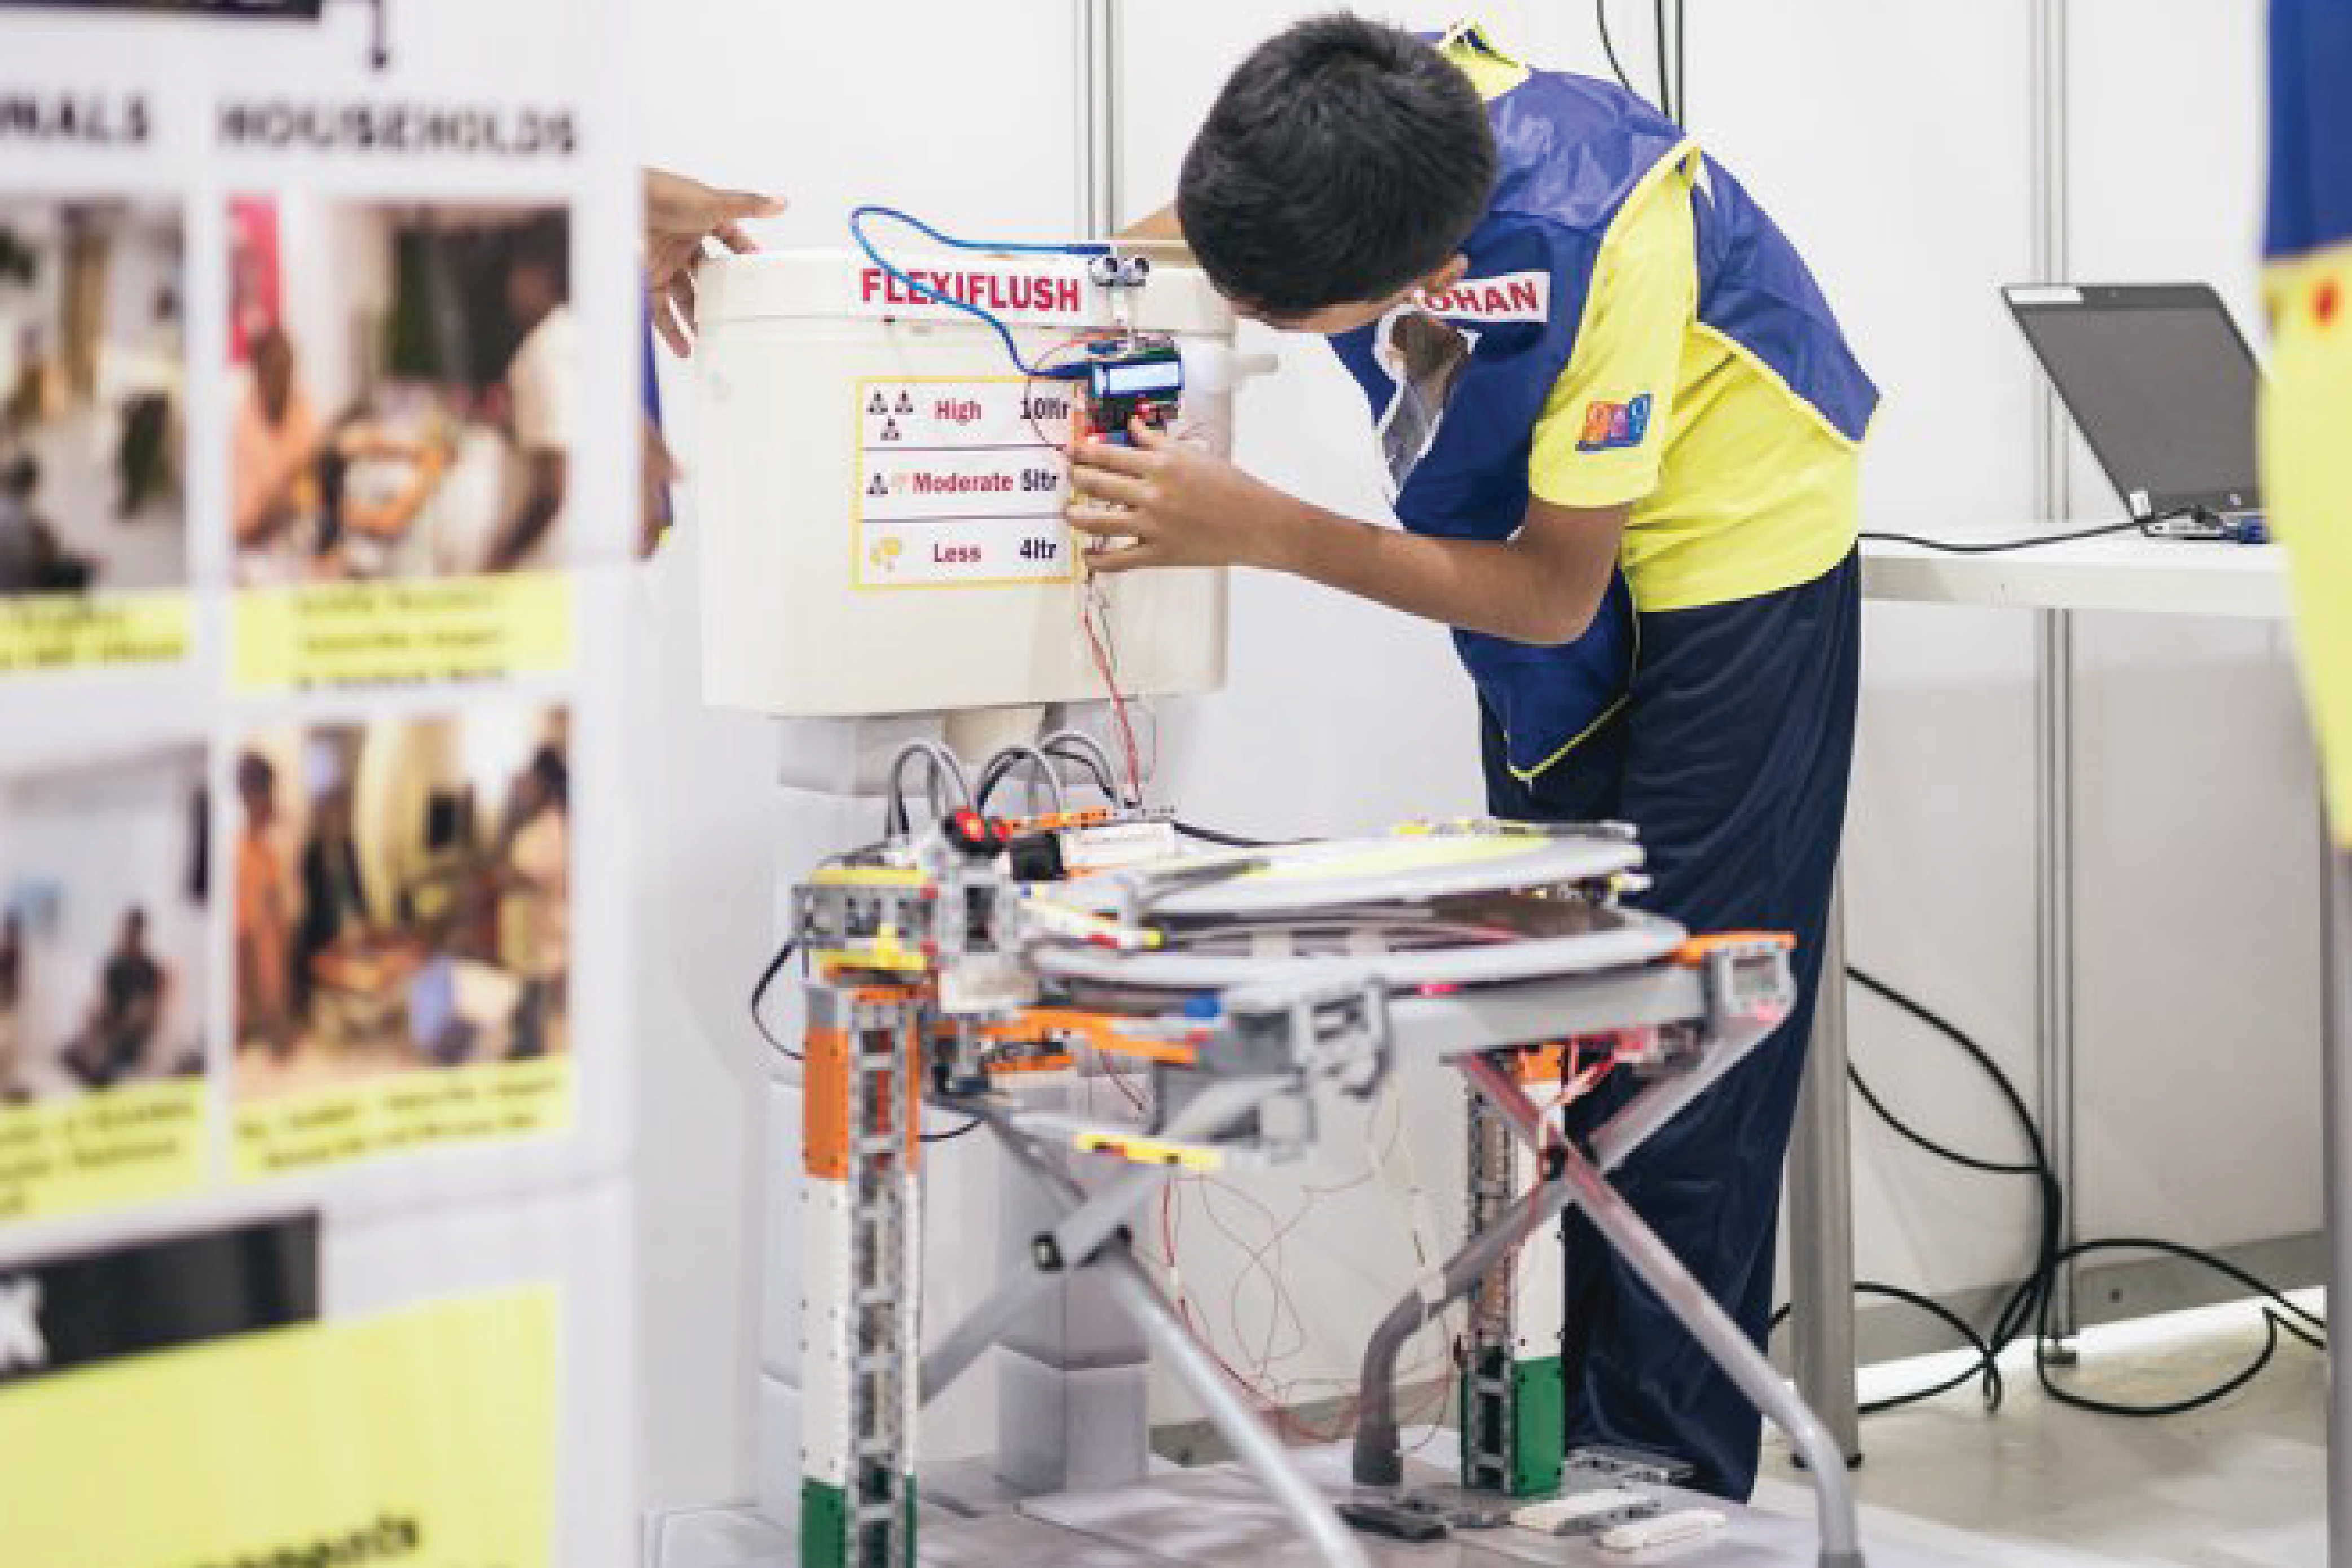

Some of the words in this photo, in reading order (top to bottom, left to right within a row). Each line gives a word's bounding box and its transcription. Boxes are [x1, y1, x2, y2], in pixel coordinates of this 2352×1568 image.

[219, 100, 576, 153] HOUSEHOLDS
[860, 268, 1081, 311] FLEXIFLUSH
[934, 400, 981, 422] High
[911, 472, 1014, 492] Moderate
[1022, 468, 1058, 491] 5ltr
[933, 543, 981, 563] Less
[1020, 537, 1058, 560] 4ltr
